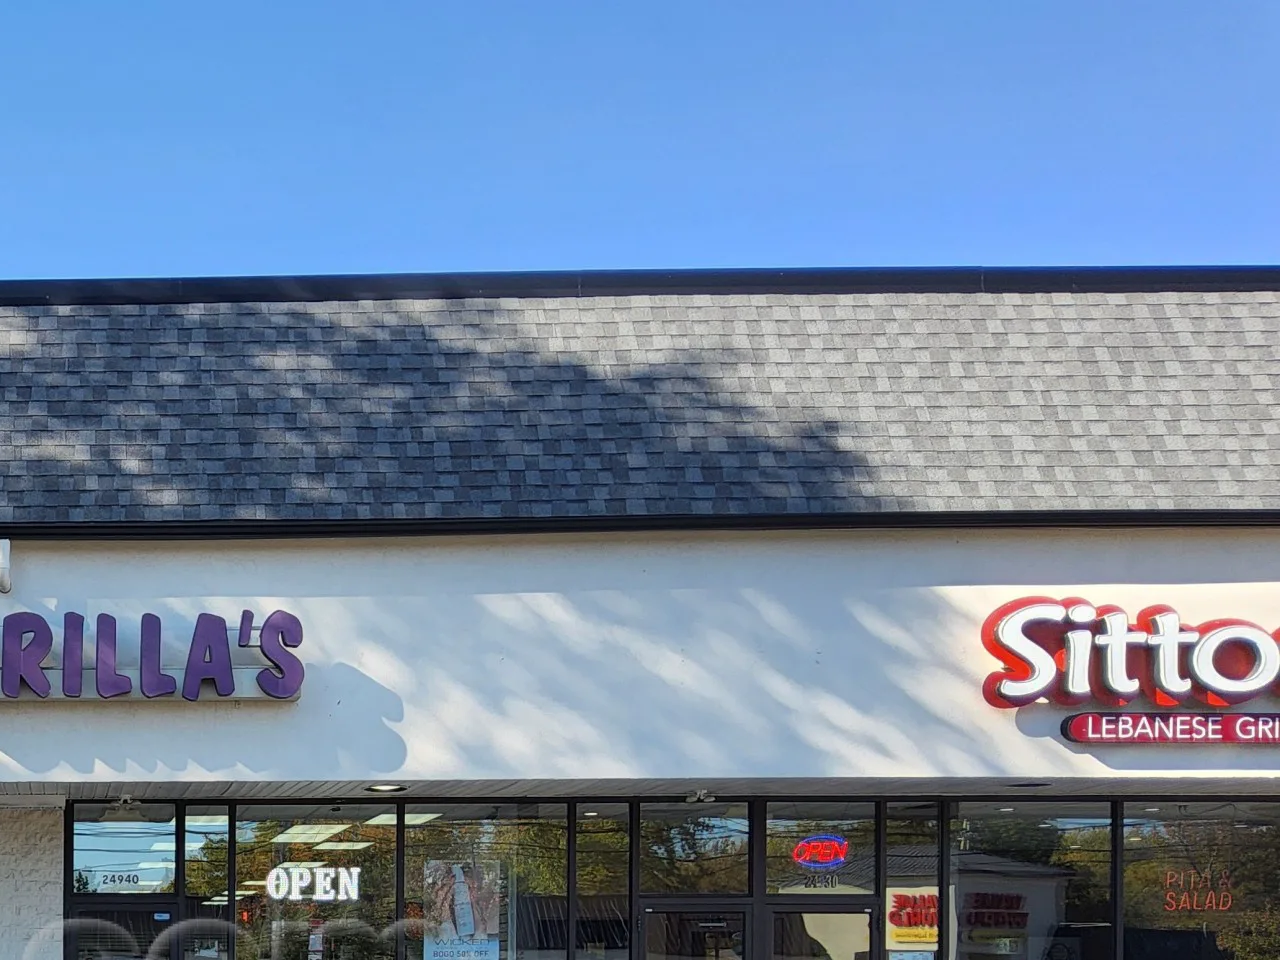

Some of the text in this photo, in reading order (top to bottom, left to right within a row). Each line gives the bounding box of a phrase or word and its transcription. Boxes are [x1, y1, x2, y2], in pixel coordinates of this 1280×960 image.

[1087, 715, 1223, 740] LEBANESE
[792, 840, 849, 862] OPEN
[102, 873, 140, 886] 24940
[265, 866, 362, 901] OPEN
[804, 874, 839, 889] 2430
[1164, 868, 1212, 890] PITA
[1163, 890, 1233, 911] SALAD
[433, 950, 455, 958] BOGO
[474, 950, 489, 958] OFF
